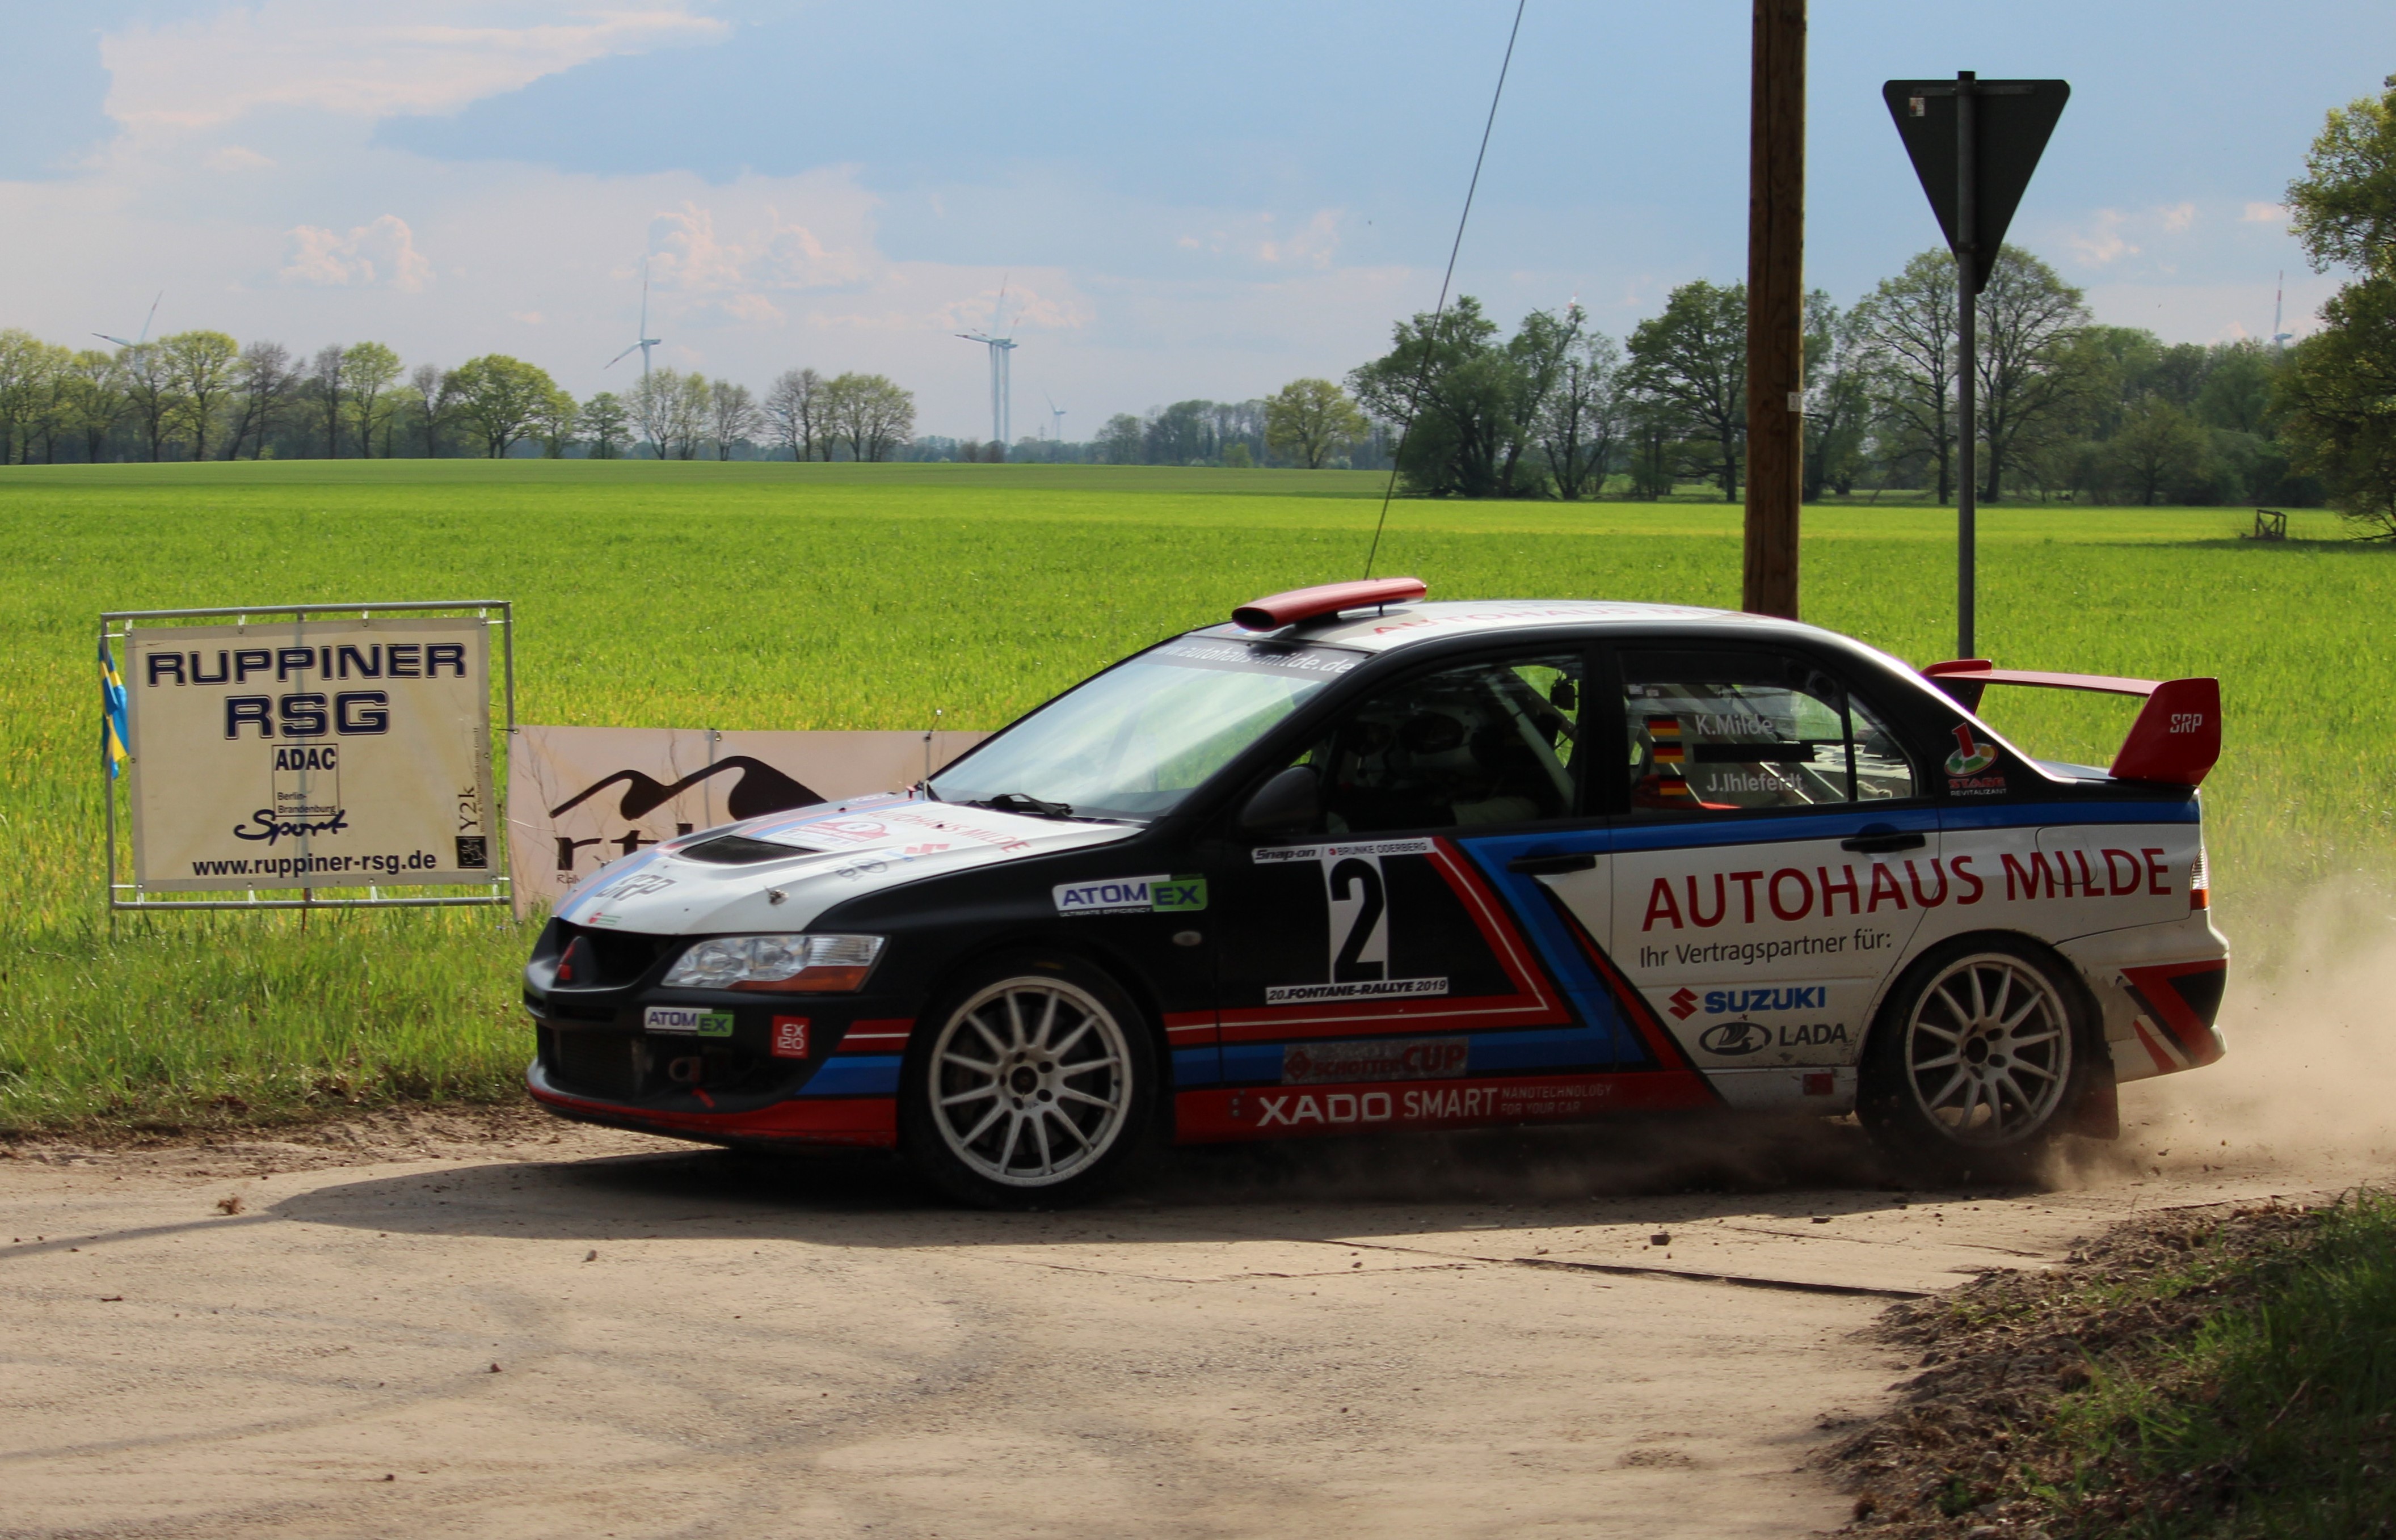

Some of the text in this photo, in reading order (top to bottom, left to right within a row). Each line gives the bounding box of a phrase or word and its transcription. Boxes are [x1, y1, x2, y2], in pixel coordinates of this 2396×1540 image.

[147, 643, 466, 687] RUPPINER
[224, 690, 389, 740] RSG
[1695, 713, 1773, 735] K.Milde
[2170, 714, 2203, 733] SRP
[275, 748, 336, 771] ADAC
[1948, 777, 2006, 790] STAGE
[277, 805, 337, 815] Brandenburg
[457, 785, 478, 832] Y2k
[233, 809, 348, 847] Sport
[555, 823, 693, 871] rt
[1254, 842, 1428, 861] Snap-on BRUNKE ODERBERG
[192, 851, 436, 878] www.ruppiner-rsg.de
[1641, 847, 2172, 932] AUTOHAUS MILDE
[1329, 857, 1386, 983] 2
[1640, 929, 1892, 969] Ihr Vertragspartner für:
[1416, 980, 1447, 993] 2019
[1704, 986, 1826, 1014] SUZUKI
[781, 1023, 806, 1037] EX
[1779, 1023, 1847, 1047] LADA
[1501, 1084, 1612, 1099] NANOTECHNOLOGY
[1256, 1087, 1498, 1126] XADO SMART
[1501, 1101, 1581, 1115] FOR YOUR CAR
